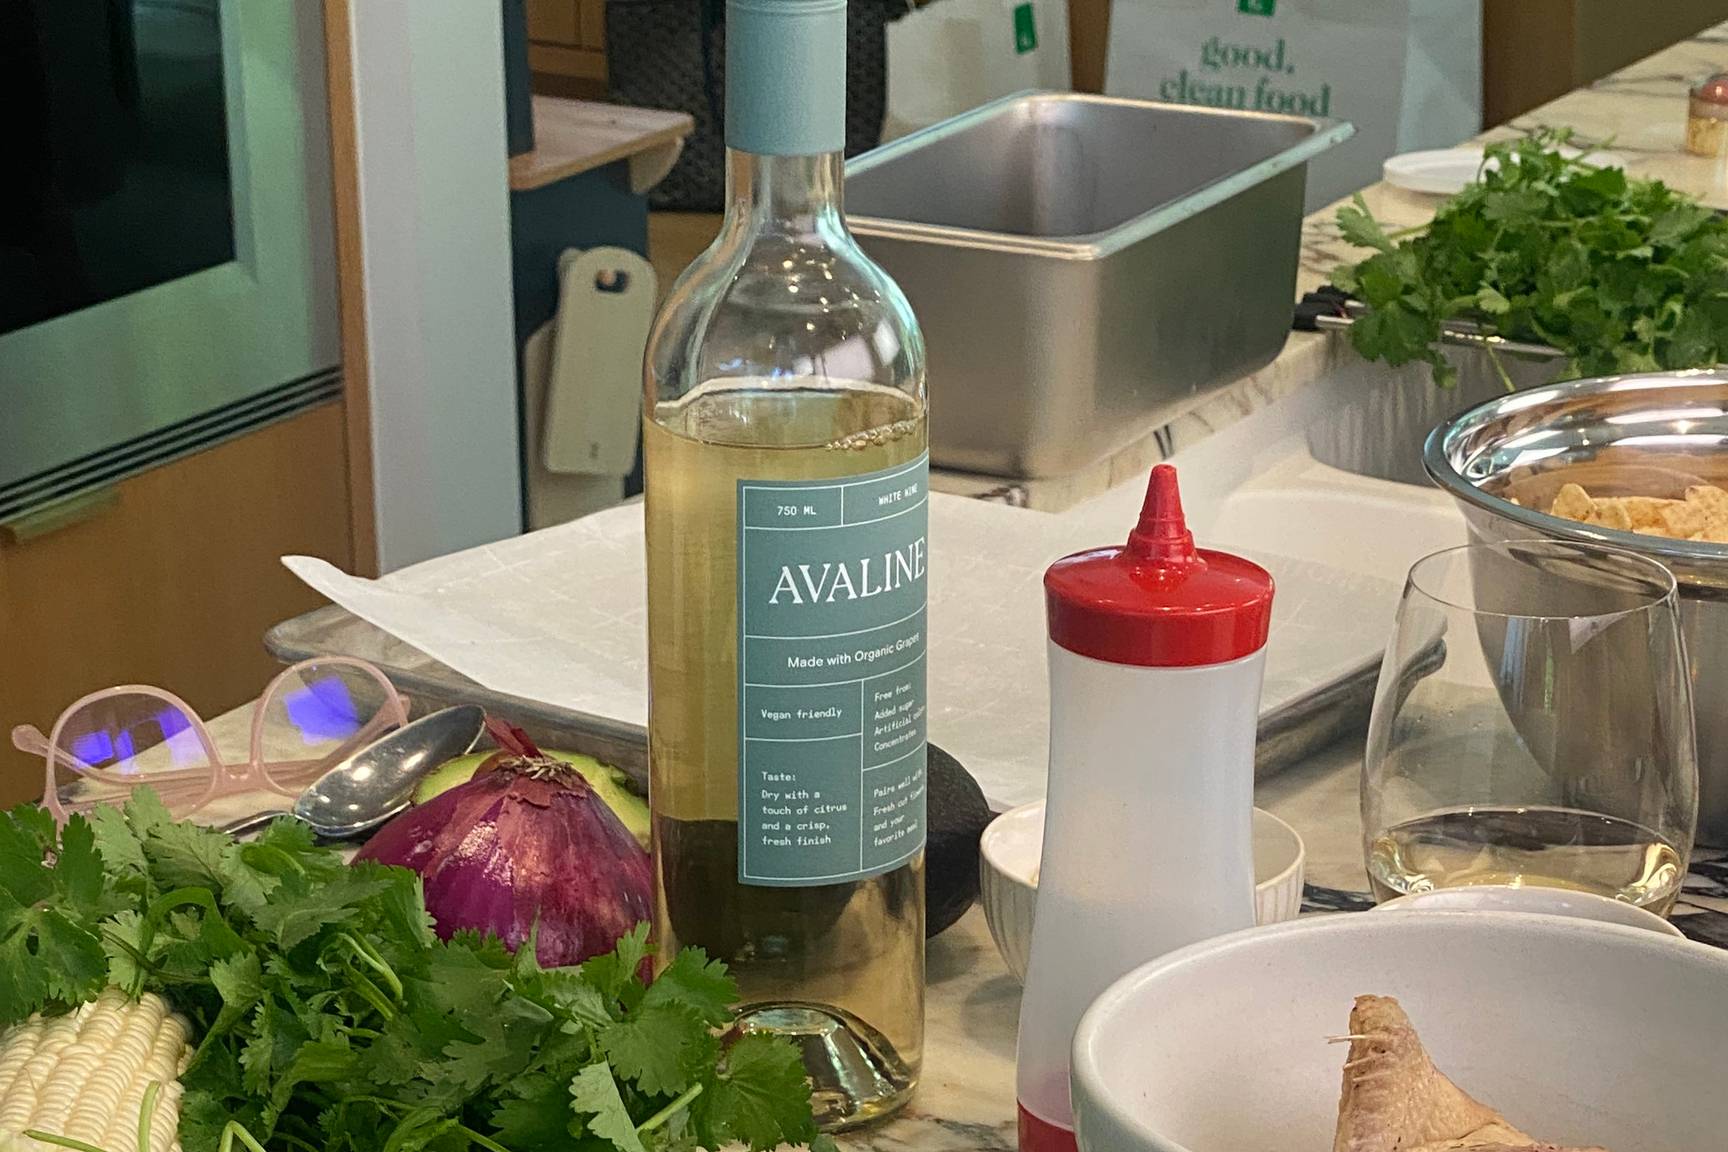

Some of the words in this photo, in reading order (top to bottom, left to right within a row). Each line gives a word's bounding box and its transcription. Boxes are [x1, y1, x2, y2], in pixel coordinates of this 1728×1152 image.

[1159, 69, 1246, 108] clean
[1255, 76, 1332, 116] food
[879, 491, 902, 505] WHITE
[777, 506, 798, 516] 750
[803, 506, 817, 516] ML
[769, 536, 926, 605] AVALINE
[788, 657, 824, 669] Made
[827, 654, 852, 666] with
[855, 644, 894, 663] Organic
[896, 632, 920, 651] Grapes
[874, 691, 893, 702] Free
[761, 709, 791, 721] Vegan
[797, 707, 843, 719] friendly
[874, 706, 897, 720] Added
[874, 714, 912, 736] Artificial
[761, 772, 796, 782] Taste:
[873, 786, 895, 798] Pairs
[898, 776, 911, 789] well
[761, 790, 779, 801] Dry
[784, 789, 809, 799] with
[763, 806, 791, 815] touch
[797, 806, 808, 815] of
[814, 803, 848, 814] citrus
[873, 802, 896, 816] Fresh
[761, 821, 780, 830] and
[873, 819, 888, 832] and
[762, 837, 791, 846] fresh
[797, 836, 832, 846] finish
[874, 830, 905, 847] favorite
